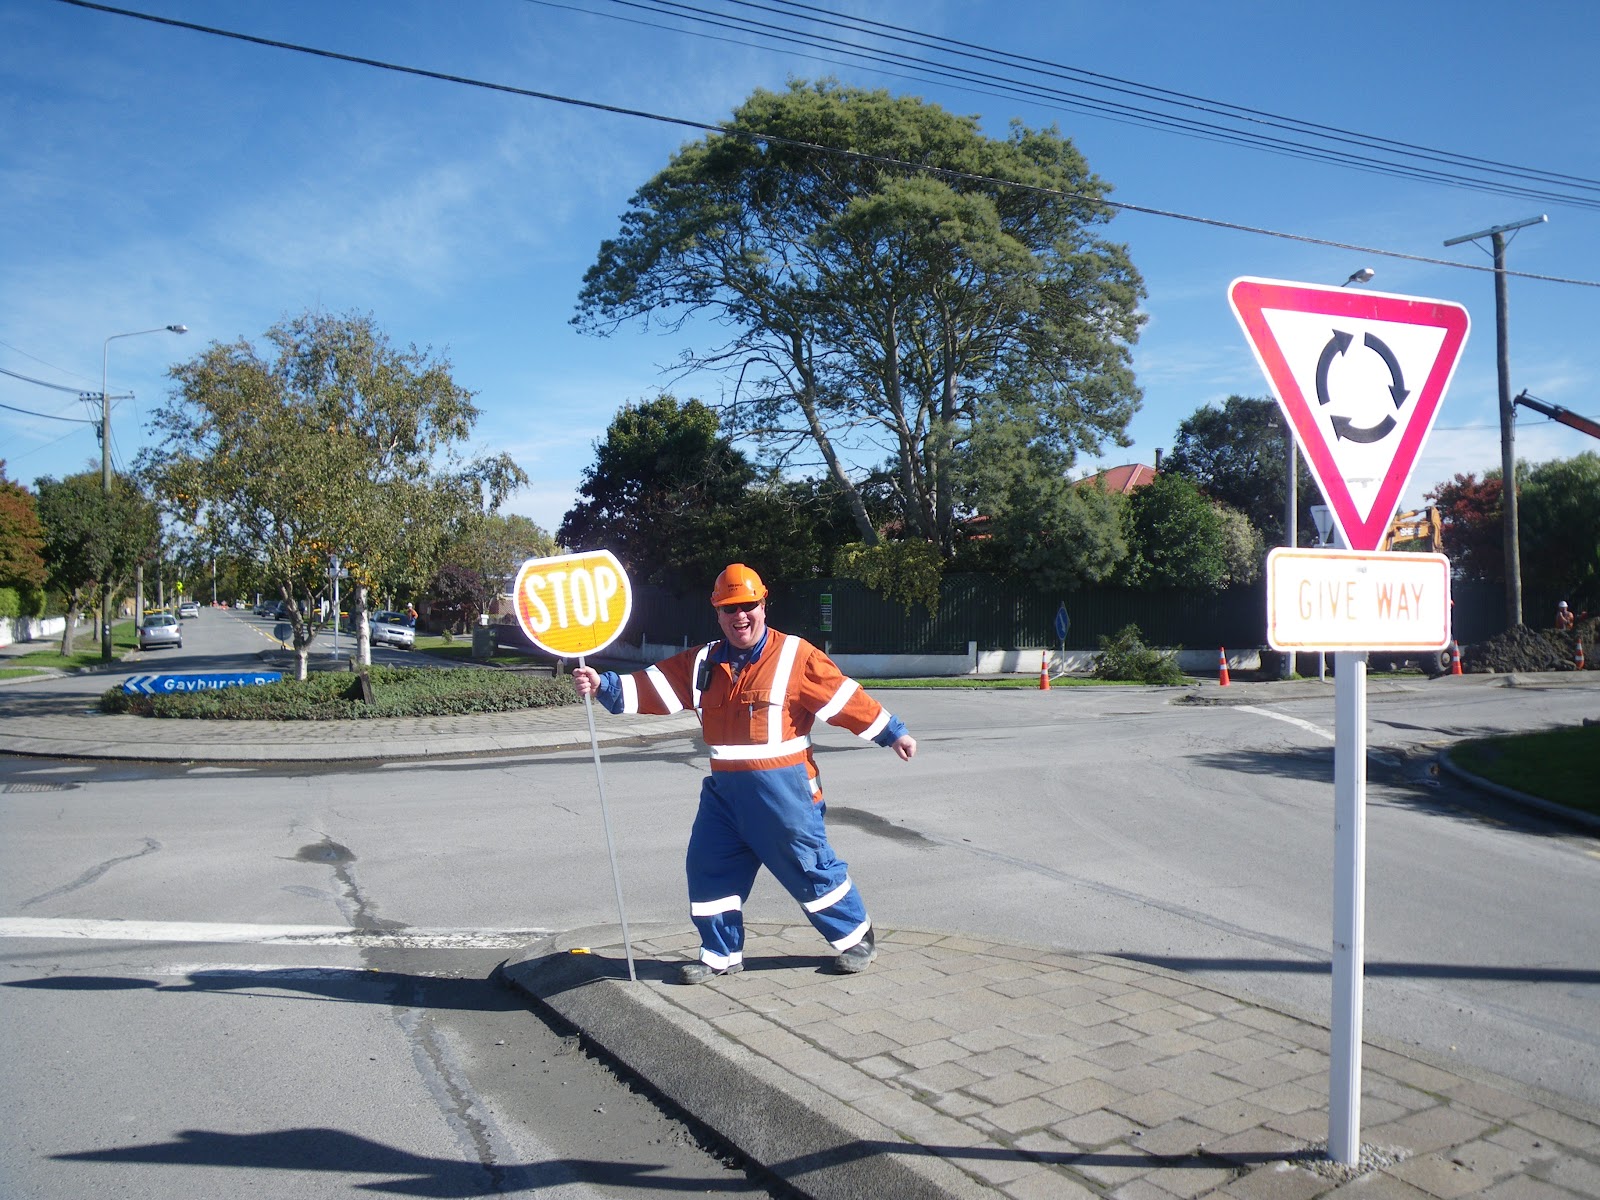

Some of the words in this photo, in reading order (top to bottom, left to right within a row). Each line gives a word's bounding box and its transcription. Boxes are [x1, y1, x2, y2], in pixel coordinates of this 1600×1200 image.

[524, 565, 618, 633] STOP
[1299, 579, 1357, 620] GIVE
[1376, 582, 1424, 620] WAY
[164, 677, 245, 690] Gayhurst
